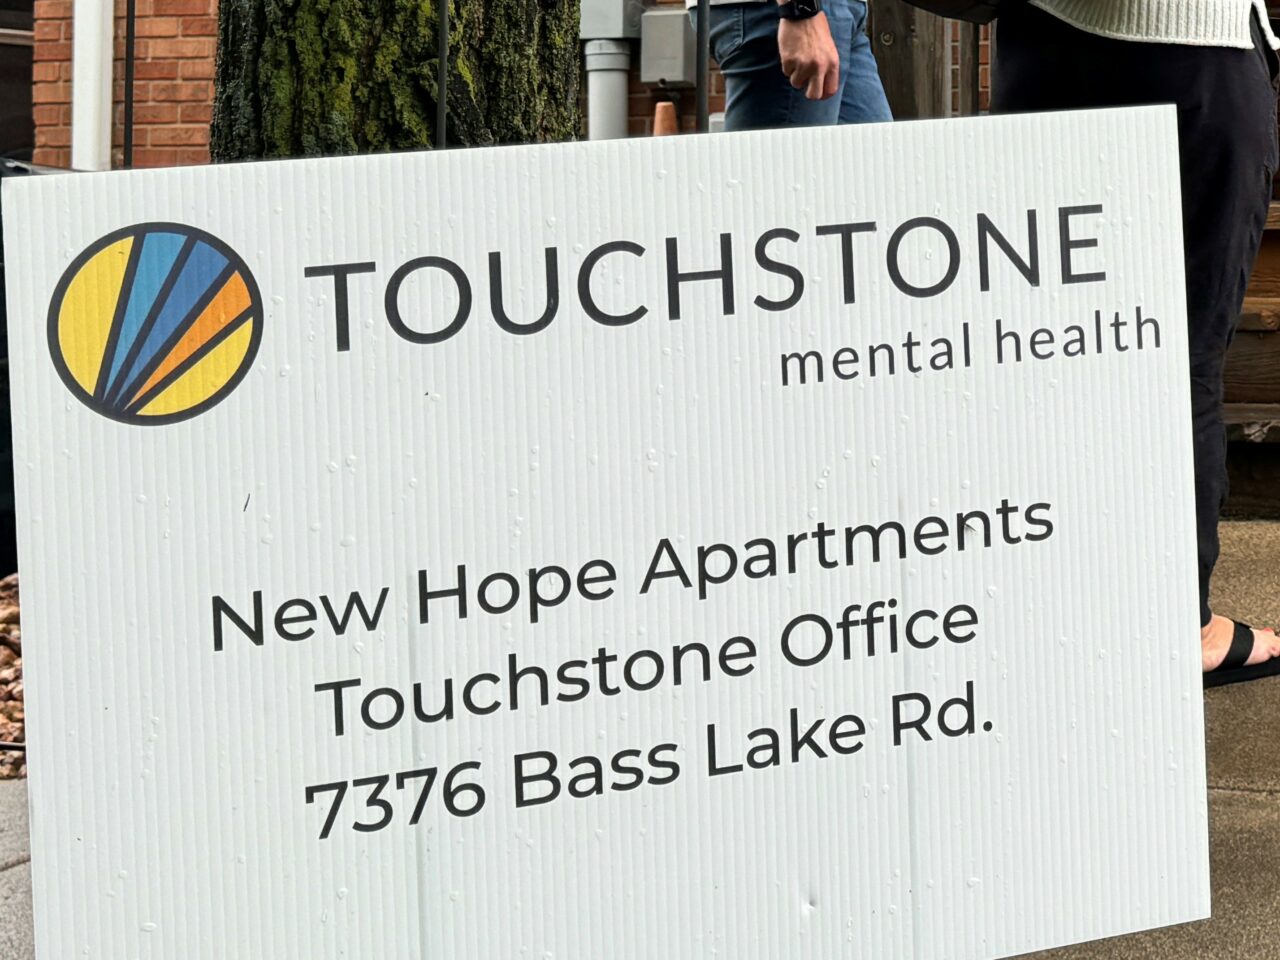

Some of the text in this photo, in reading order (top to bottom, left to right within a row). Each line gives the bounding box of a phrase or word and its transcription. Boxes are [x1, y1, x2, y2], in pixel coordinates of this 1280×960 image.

[305, 205, 1107, 351] TOUCHSTONE
[781, 306, 1161, 386] mental health
[212, 500, 1055, 651] New Hope Apartments
[315, 600, 979, 737] Touchstone Office
[305, 681, 994, 840] 7376 Bass Lake Rd.
